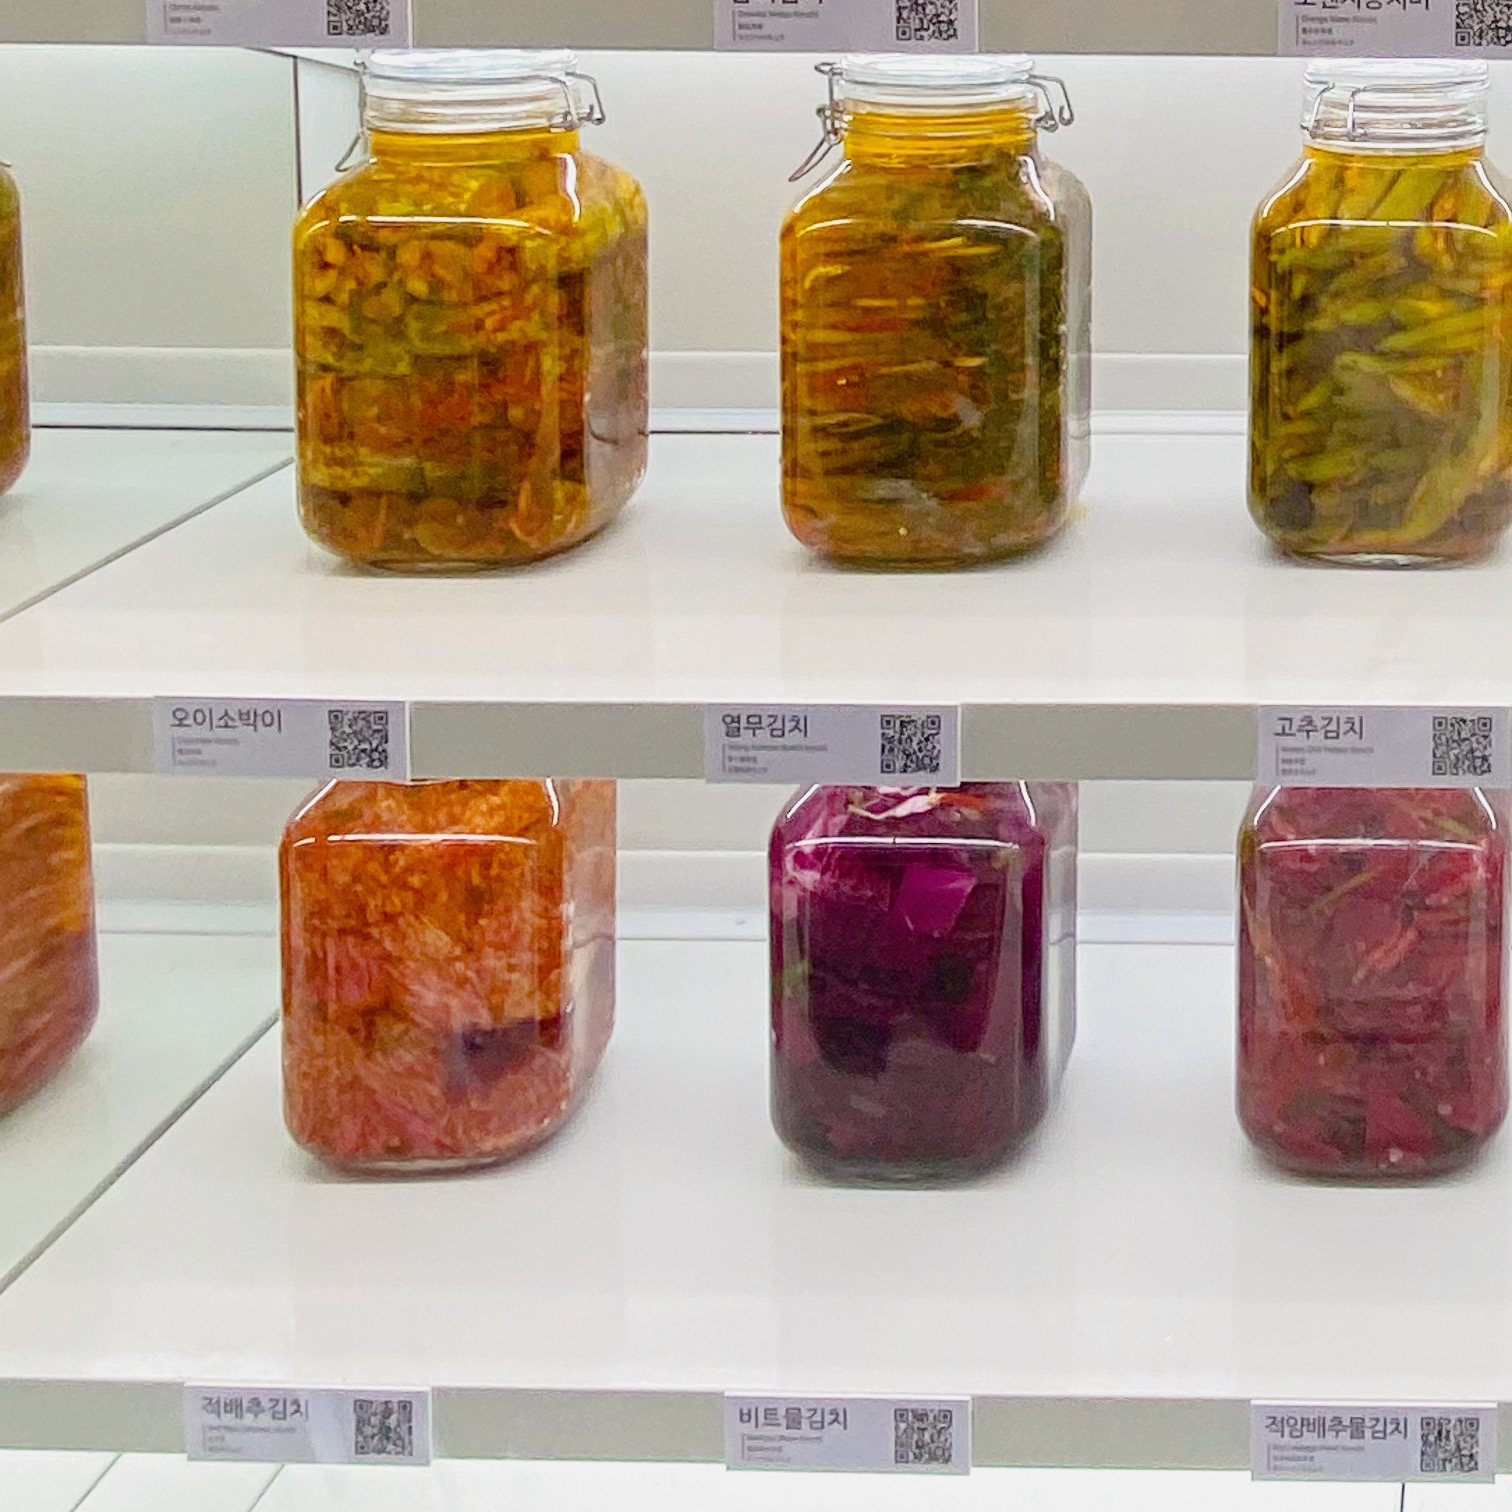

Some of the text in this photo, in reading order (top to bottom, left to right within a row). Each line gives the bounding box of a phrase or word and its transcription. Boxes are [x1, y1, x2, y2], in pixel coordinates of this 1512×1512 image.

[169, 707, 282, 733] 오이소박이
[721, 713, 808, 738] 열무김치
[1273, 715, 1364, 740] 고추김치
[201, 1396, 308, 1422] 적배추김치
[1265, 1416, 1408, 1440] 적양배추물김치
